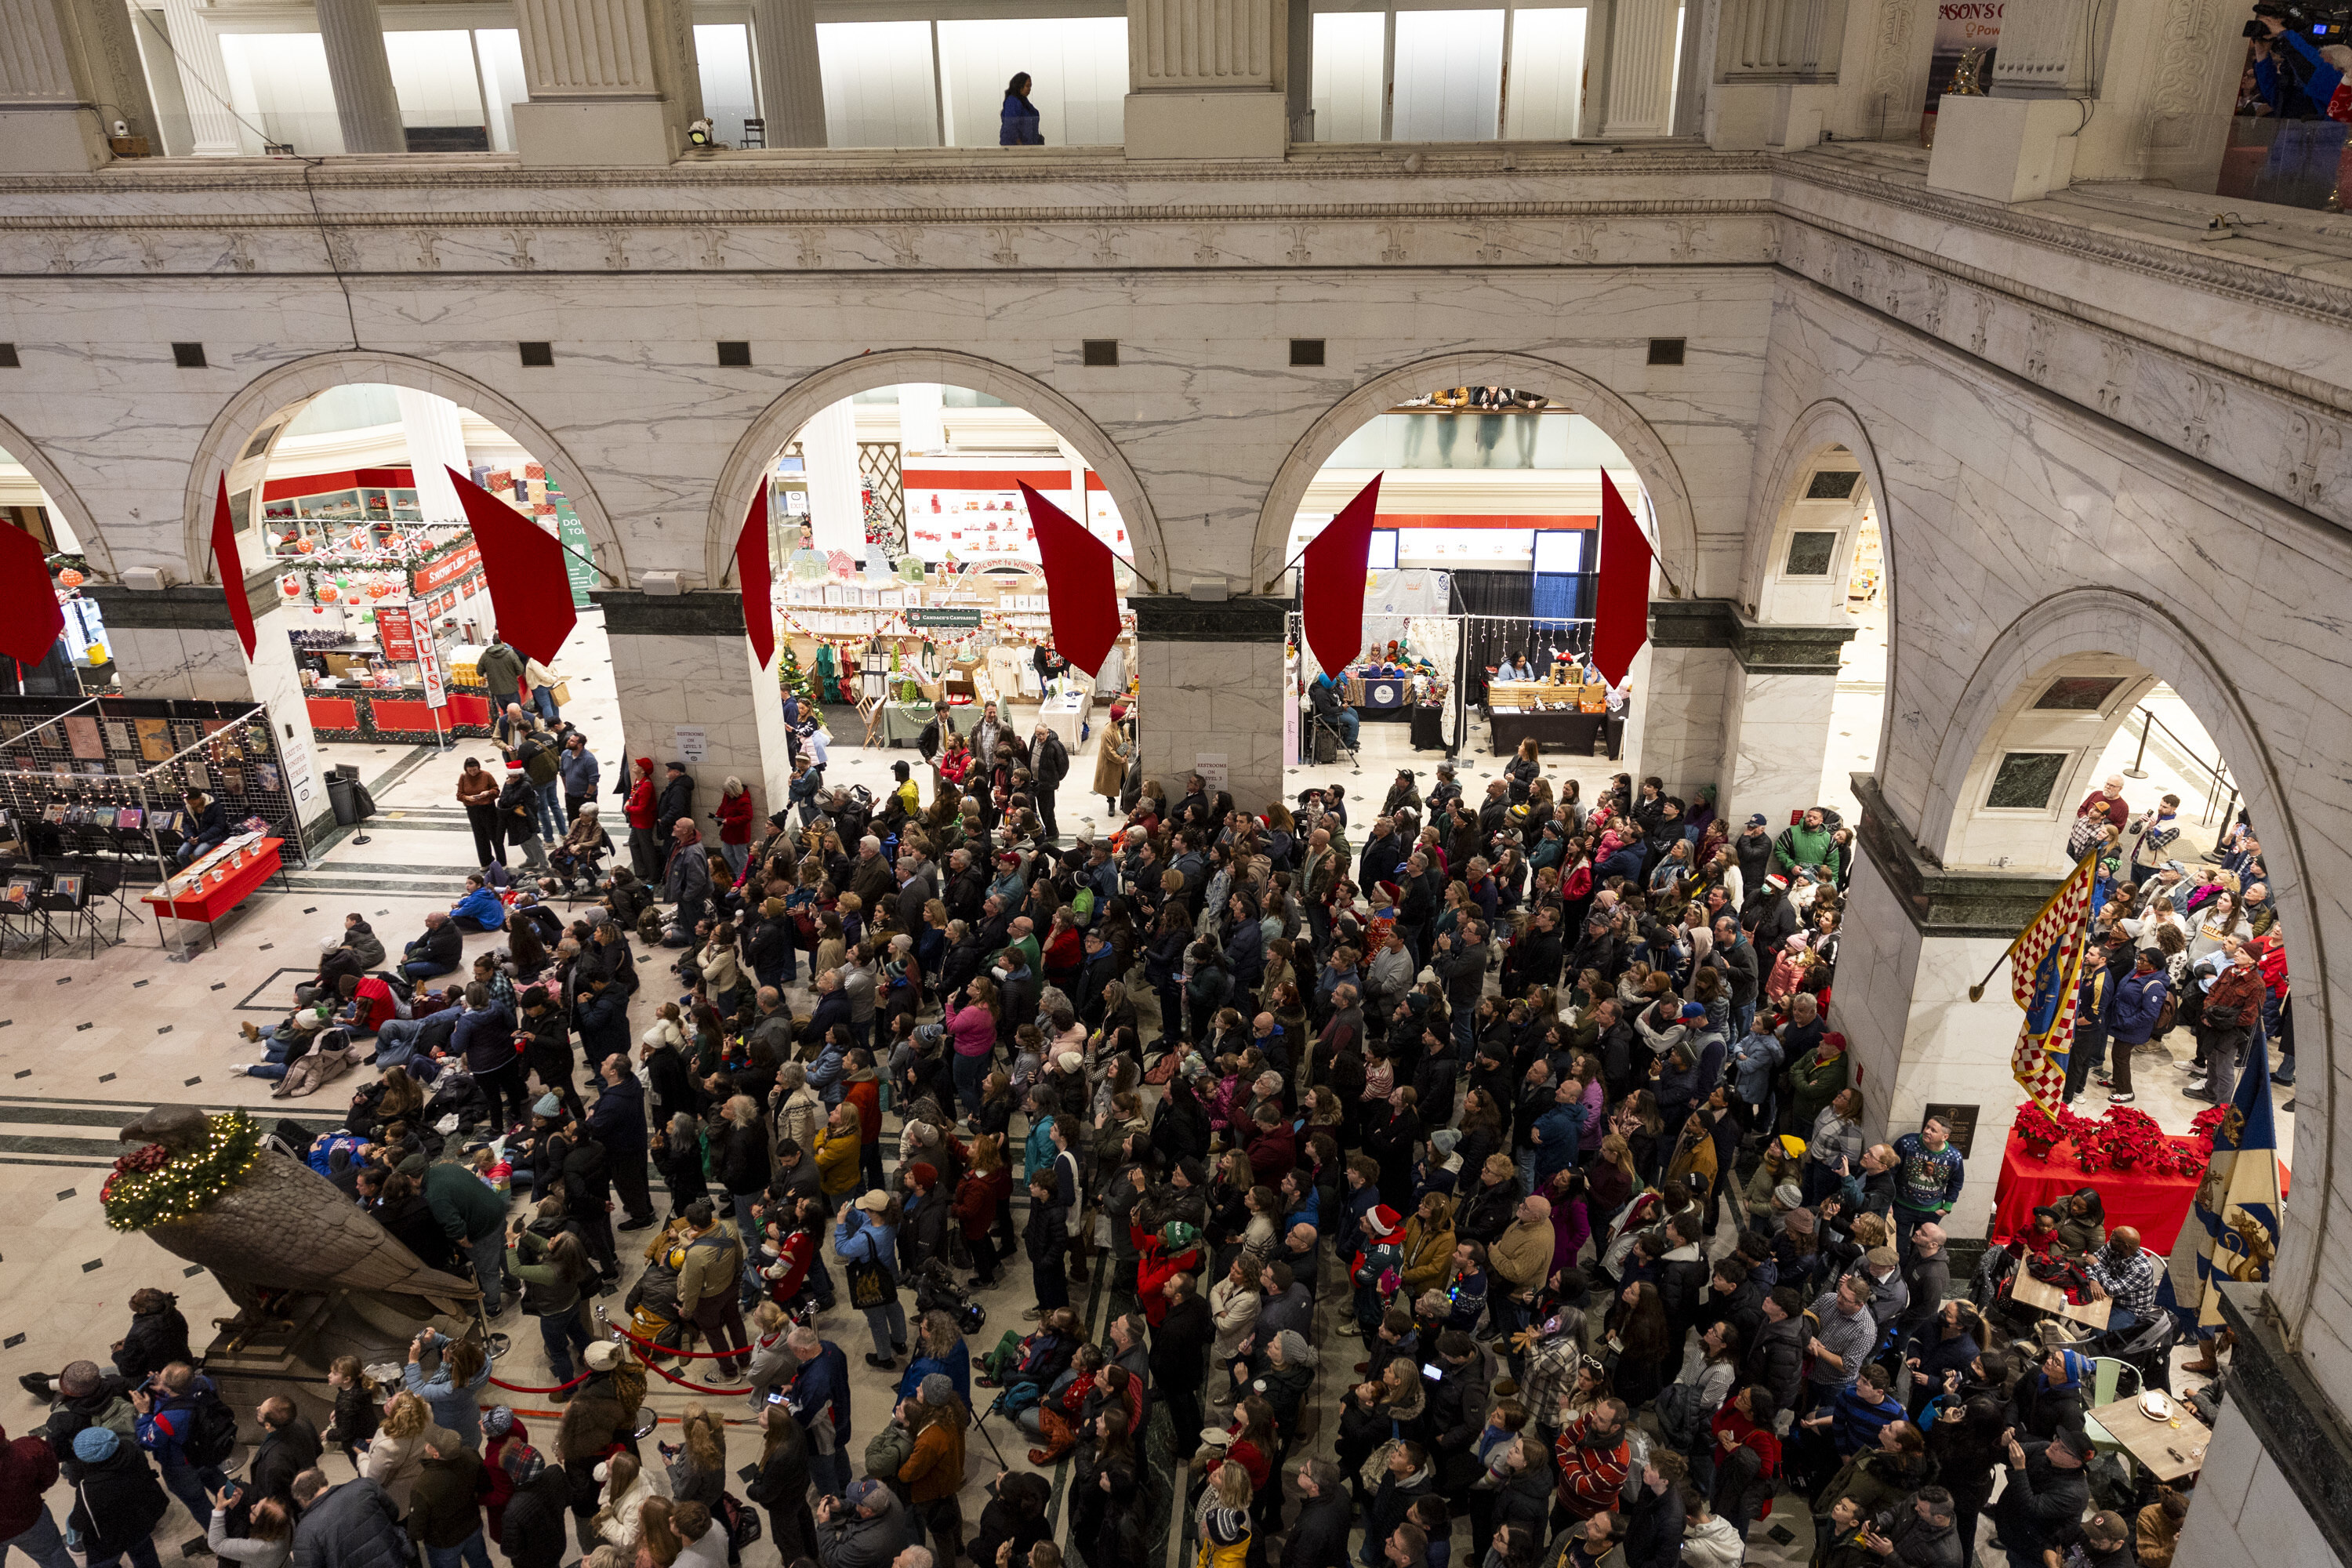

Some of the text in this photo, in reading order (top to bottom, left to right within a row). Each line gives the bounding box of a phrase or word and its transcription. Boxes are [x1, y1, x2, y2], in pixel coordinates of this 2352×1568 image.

[429, 554, 466, 584] SNOWFLAKE
[970, 559, 1002, 576] Welcome
[414, 619, 440, 691] NUTS
[1915, 1152, 1929, 1161] SON
[1377, 1243, 1391, 1255] 90
